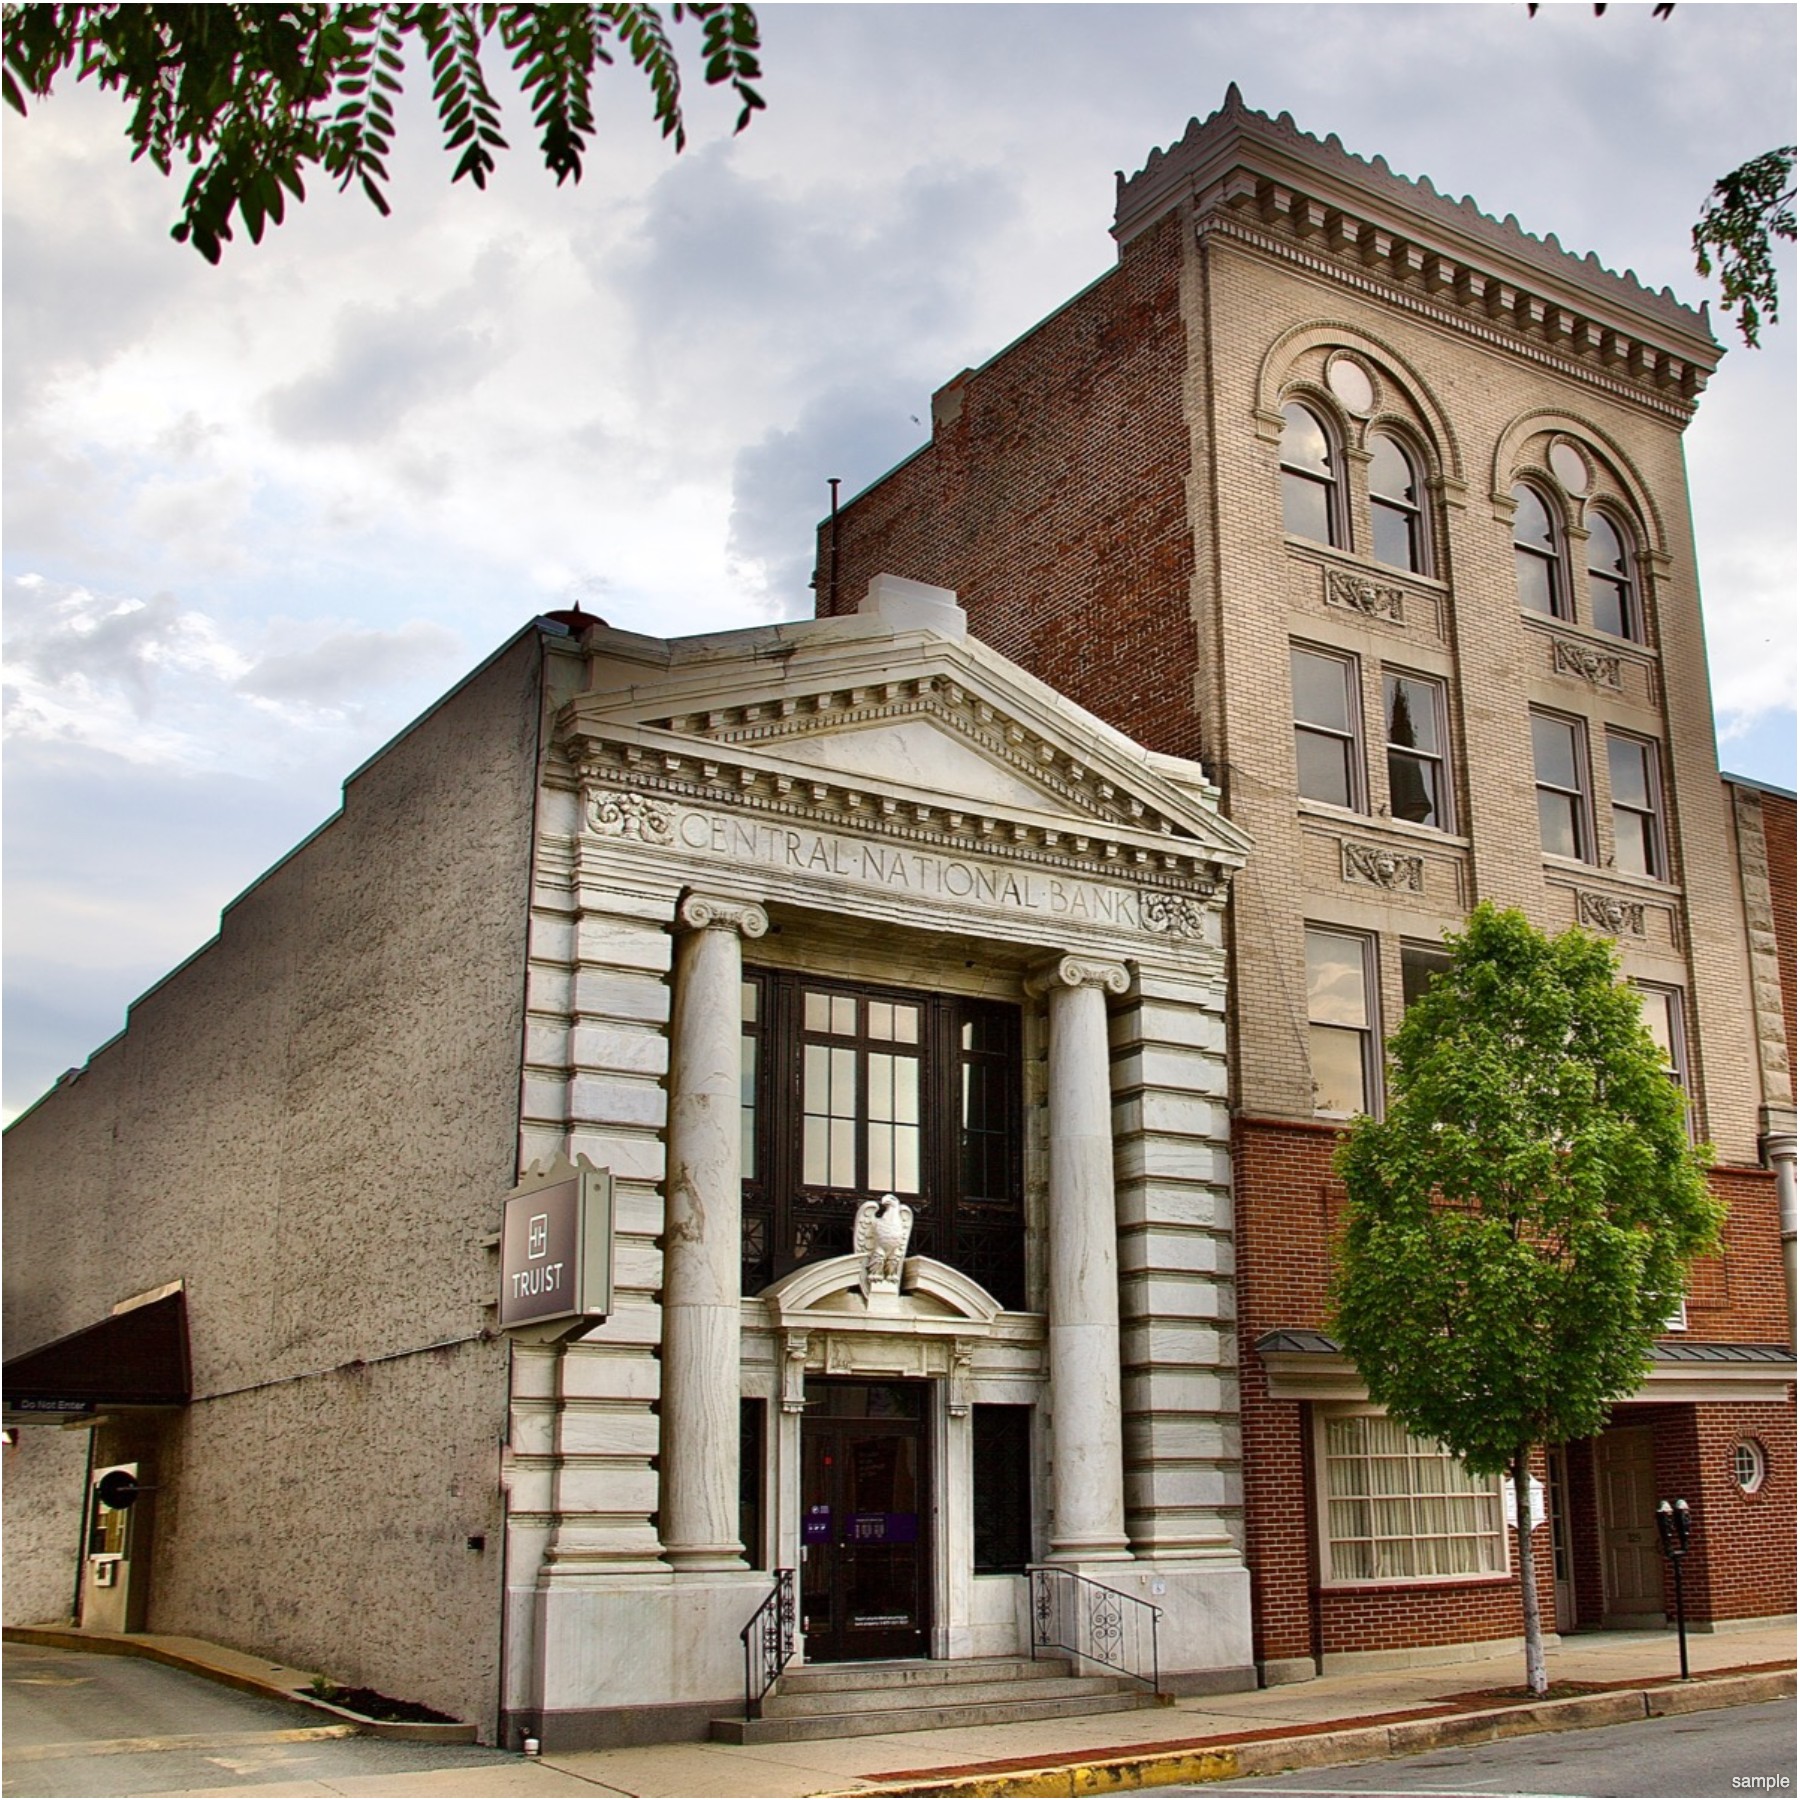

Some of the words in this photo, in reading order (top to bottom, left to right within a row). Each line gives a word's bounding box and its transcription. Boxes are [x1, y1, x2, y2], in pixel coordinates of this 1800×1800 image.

[681, 812, 849, 874] CENTRAL
[861, 846, 1038, 908] NATIONAL
[1053, 883, 1136, 925] BANK
[512, 1263, 563, 1298] TRUIST
[21, 1399, 36, 1409] Do
[37, 1400, 56, 1409] Not
[57, 1400, 86, 1410] Enter
